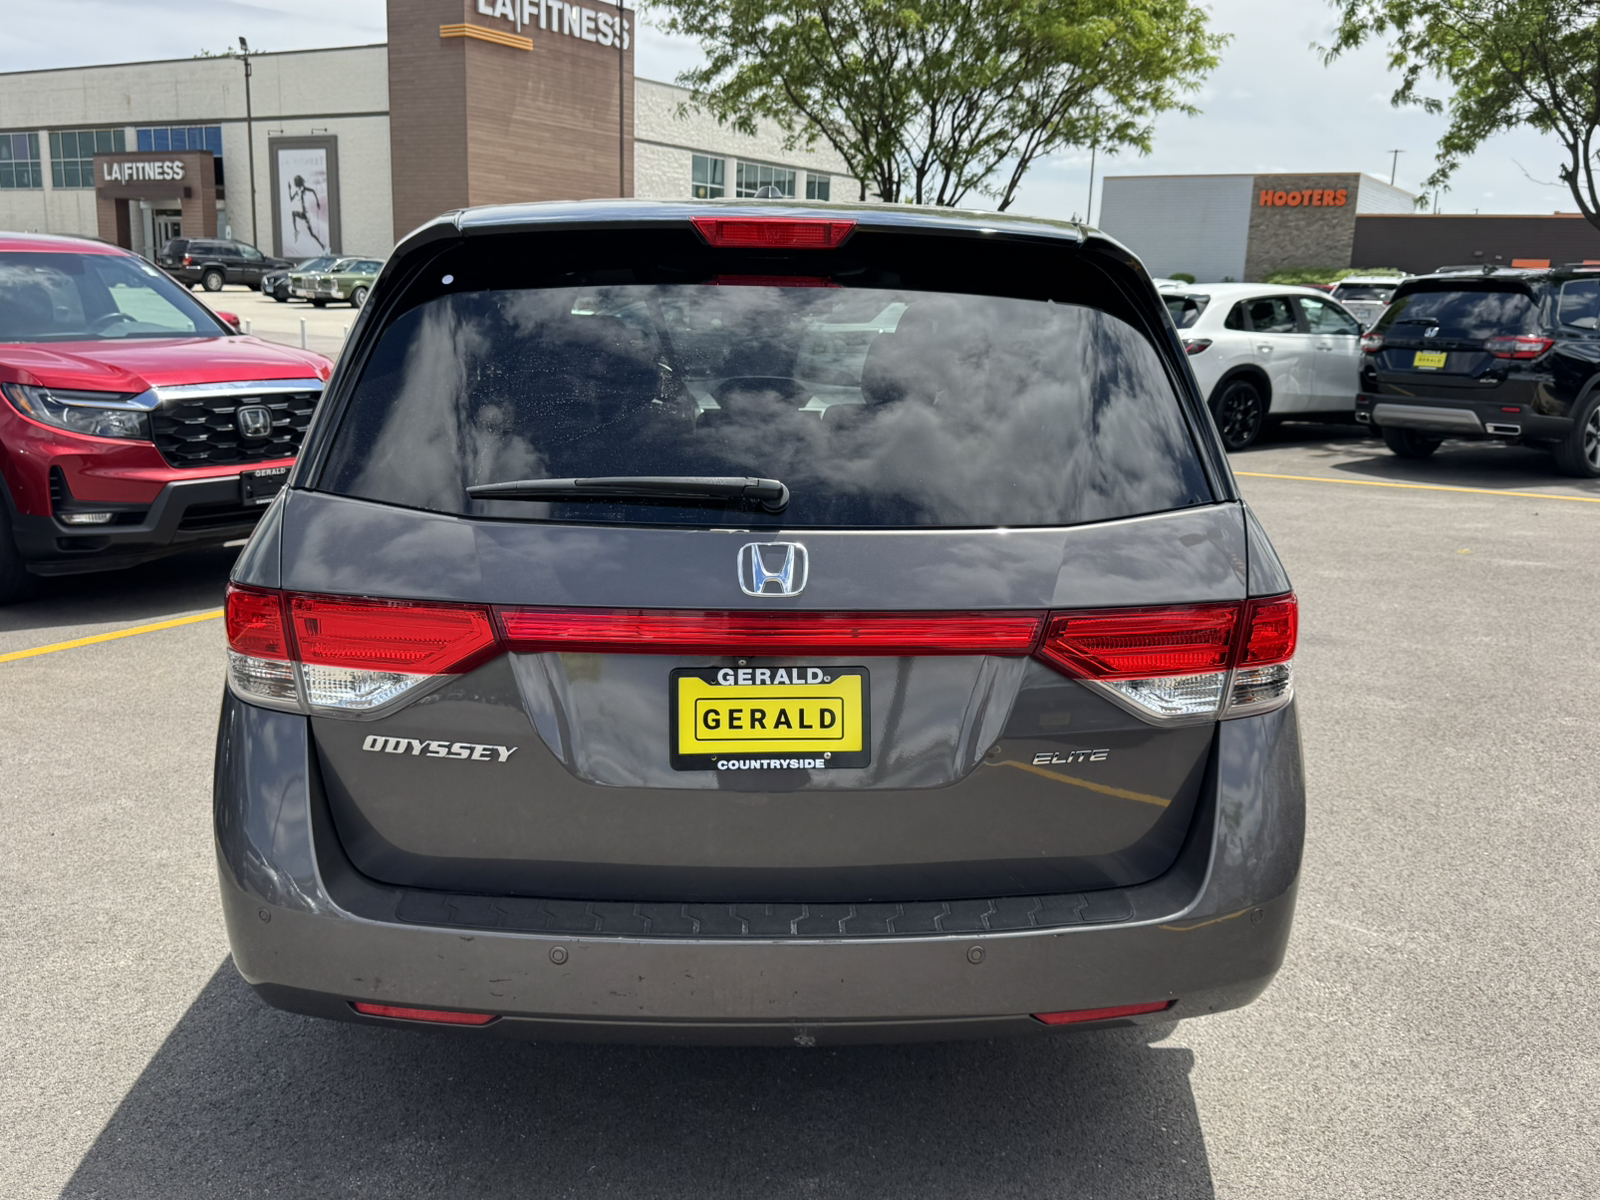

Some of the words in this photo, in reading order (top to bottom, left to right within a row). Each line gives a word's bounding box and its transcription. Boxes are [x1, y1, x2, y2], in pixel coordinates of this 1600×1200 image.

[1259, 189, 1347, 207] HOOTERS
[255, 468, 286, 477] GERALD
[717, 668, 824, 686] GERALD
[702, 708, 837, 730] GERALD
[362, 734, 519, 763] ODYSSEY
[1032, 748, 1110, 766] ELITE
[717, 759, 825, 770] COUNTRYSIDE
